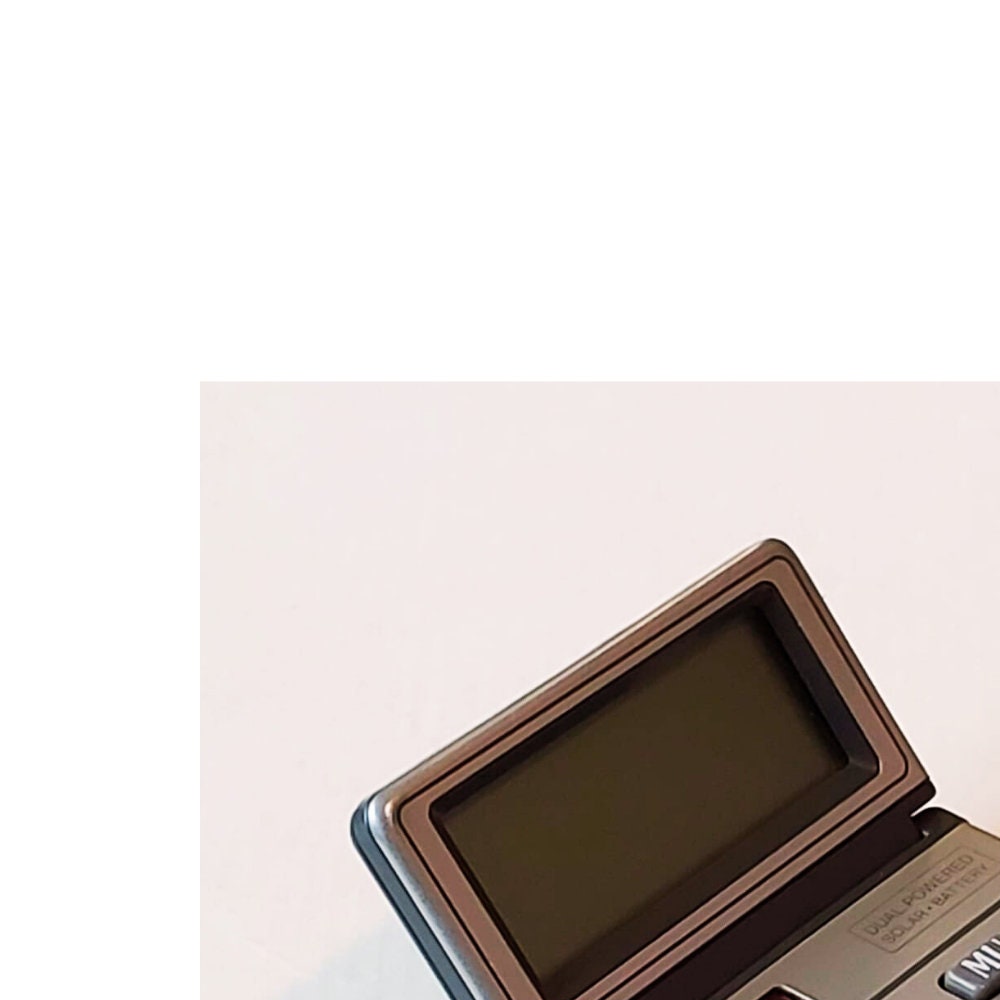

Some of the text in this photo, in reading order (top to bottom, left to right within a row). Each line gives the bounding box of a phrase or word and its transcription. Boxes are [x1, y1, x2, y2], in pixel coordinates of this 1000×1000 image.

[865, 854, 974, 936] DUAL POWERED
[881, 910, 929, 944] SOLAR
[930, 863, 989, 907] BATTERY
